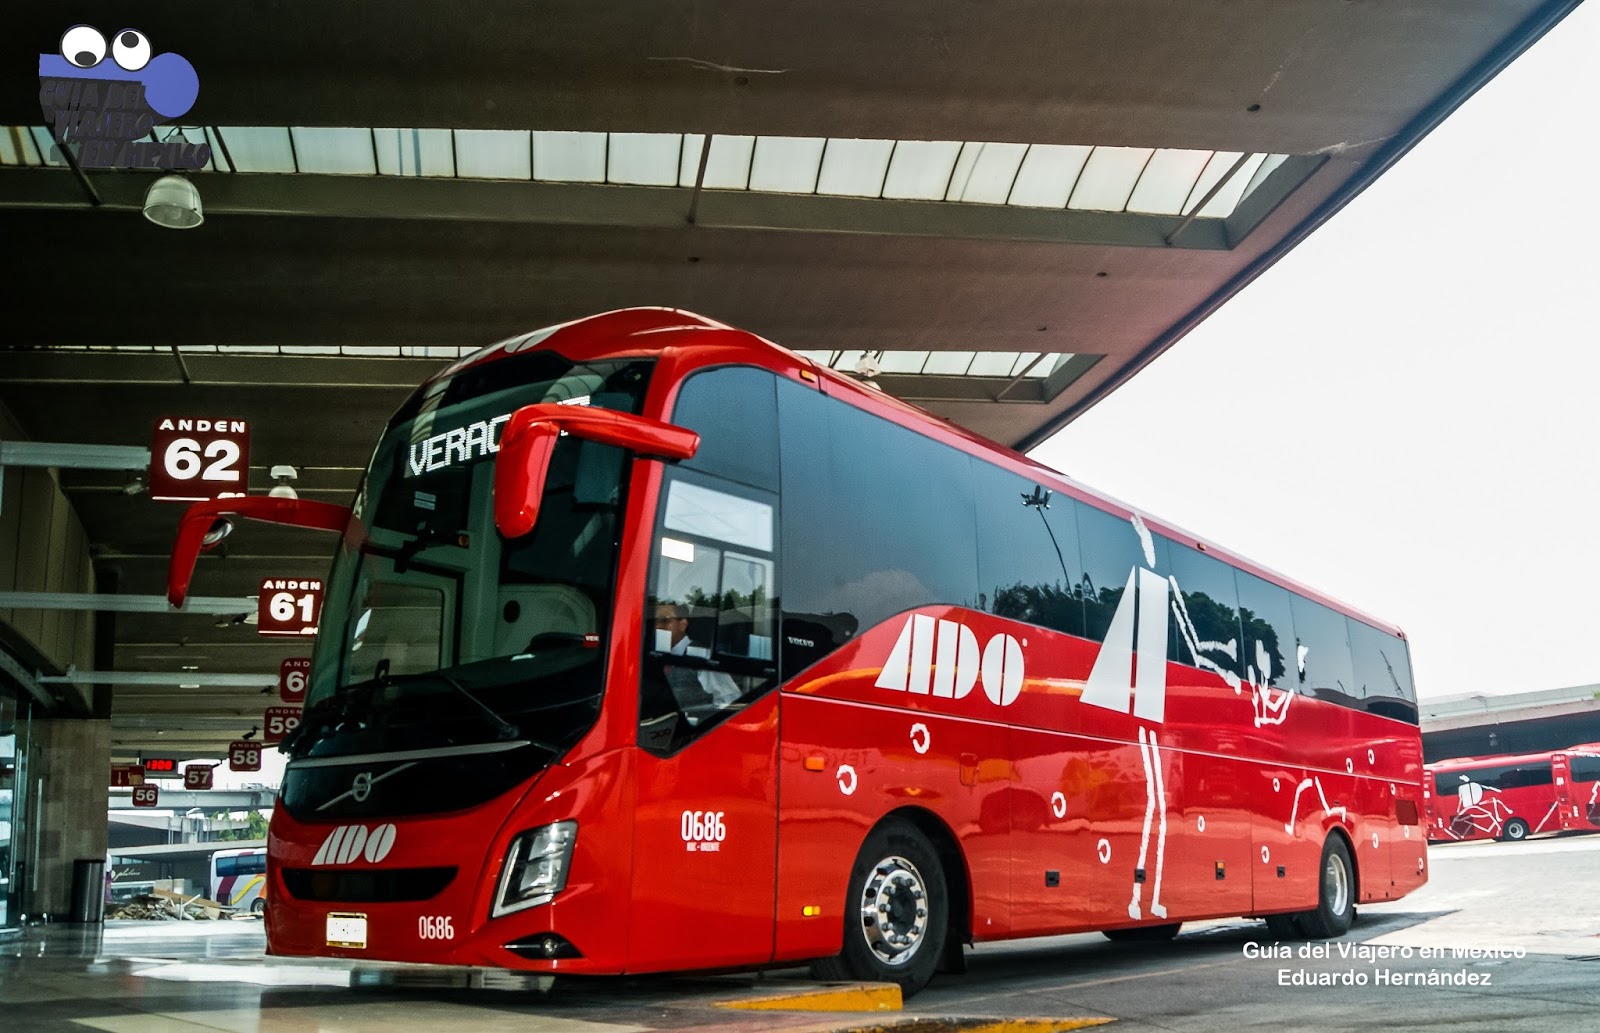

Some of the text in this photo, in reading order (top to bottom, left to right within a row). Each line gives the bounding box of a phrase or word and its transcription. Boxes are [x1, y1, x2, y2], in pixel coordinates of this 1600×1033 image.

[159, 419, 246, 433] ANDEN
[164, 438, 240, 481] 62
[263, 580, 321, 591] ANDEN
[269, 592, 315, 622] 61
[284, 660, 311, 668] AND
[874, 613, 1025, 707] ADO
[286, 671, 310, 693] 6
[269, 716, 300, 734] 59
[232, 751, 259, 765] 58
[188, 771, 211, 785] 57
[135, 789, 156, 801] 56
[681, 810, 726, 842] 0686
[311, 823, 397, 866] ADO
[418, 915, 455, 940] 0686
